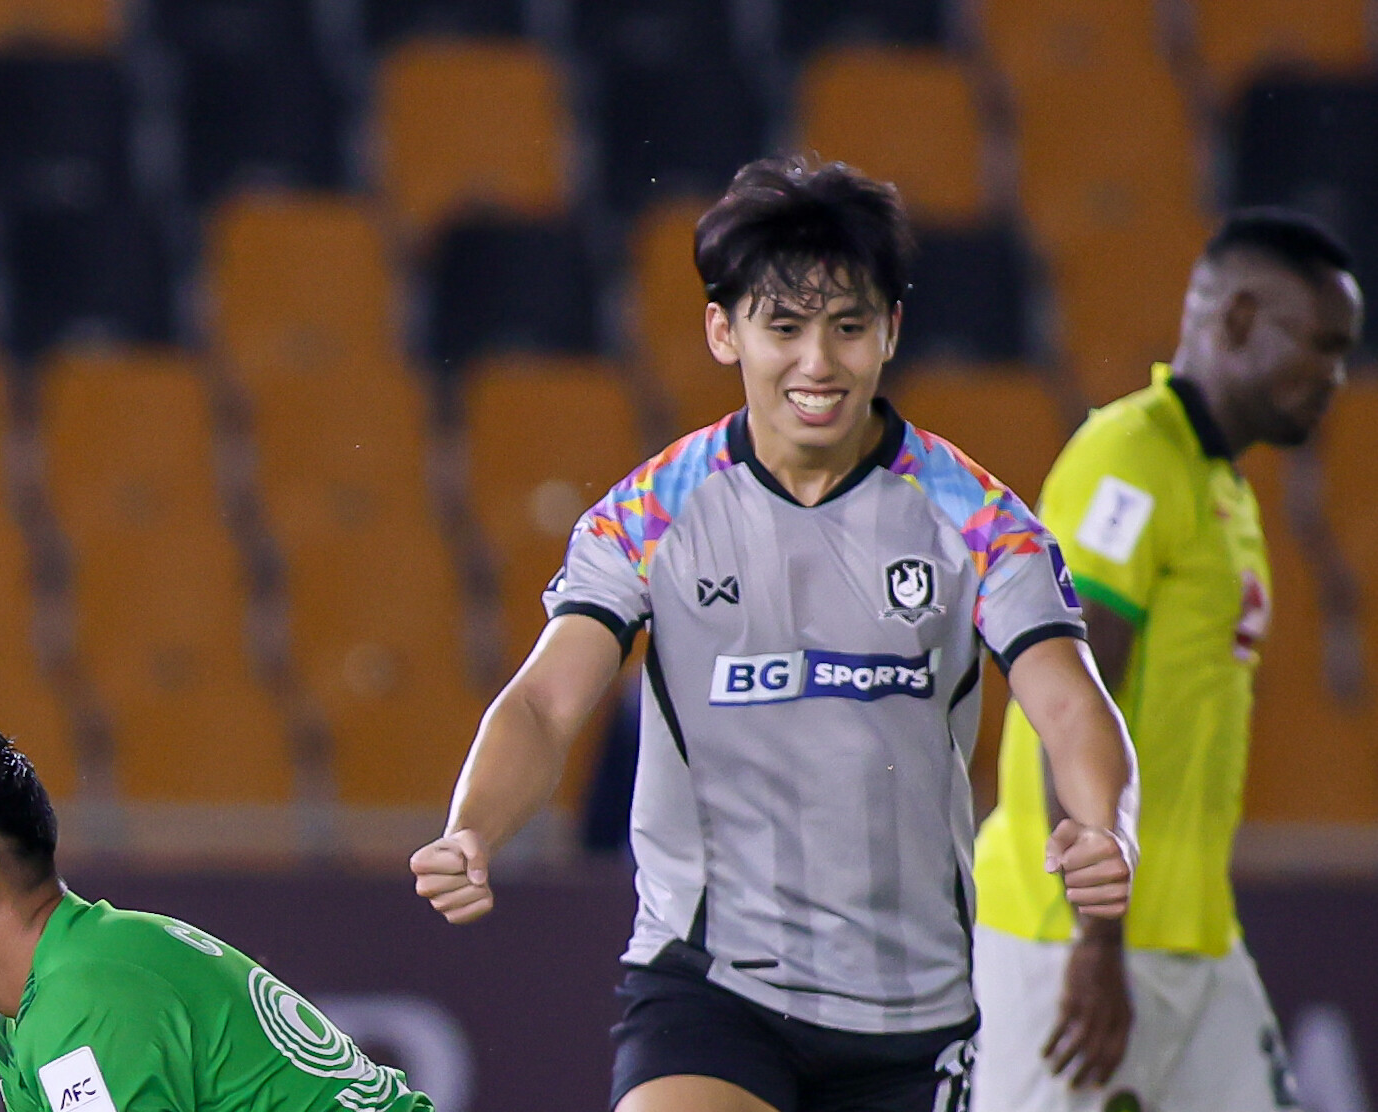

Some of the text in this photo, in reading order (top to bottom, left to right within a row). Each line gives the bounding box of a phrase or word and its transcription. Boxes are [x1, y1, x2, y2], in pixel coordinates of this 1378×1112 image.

[726, 659, 929, 693] BG SPORTS
[60, 1077, 96, 1110] AFC
